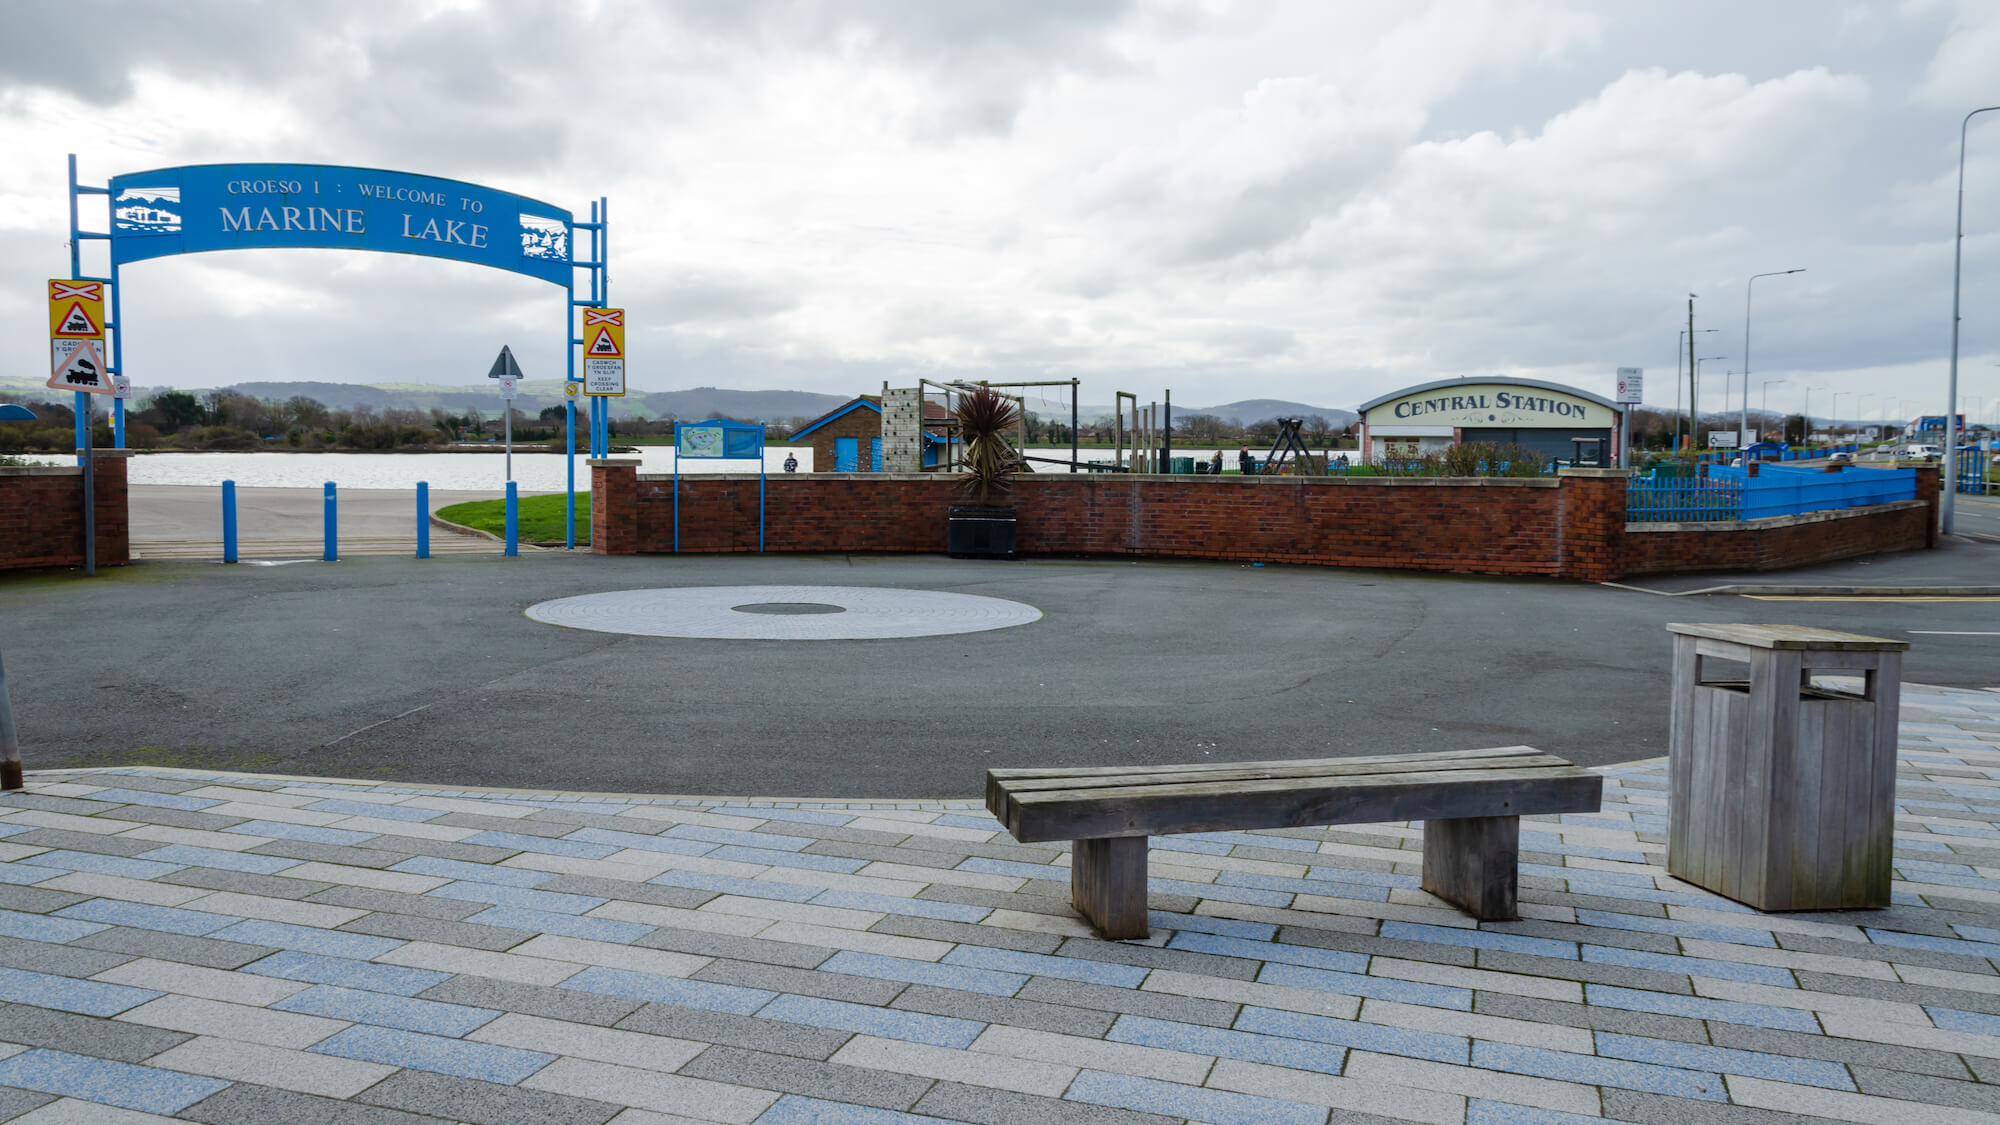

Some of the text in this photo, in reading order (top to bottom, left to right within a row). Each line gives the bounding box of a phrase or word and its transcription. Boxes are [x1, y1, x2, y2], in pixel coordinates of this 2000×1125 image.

[227, 180, 302, 194] CROESO
[358, 183, 447, 206] WELCOME
[460, 197, 483, 213] TO
[219, 206, 489, 249] MARINE LAKE
[1394, 391, 1587, 420] CENTRAL STATION
